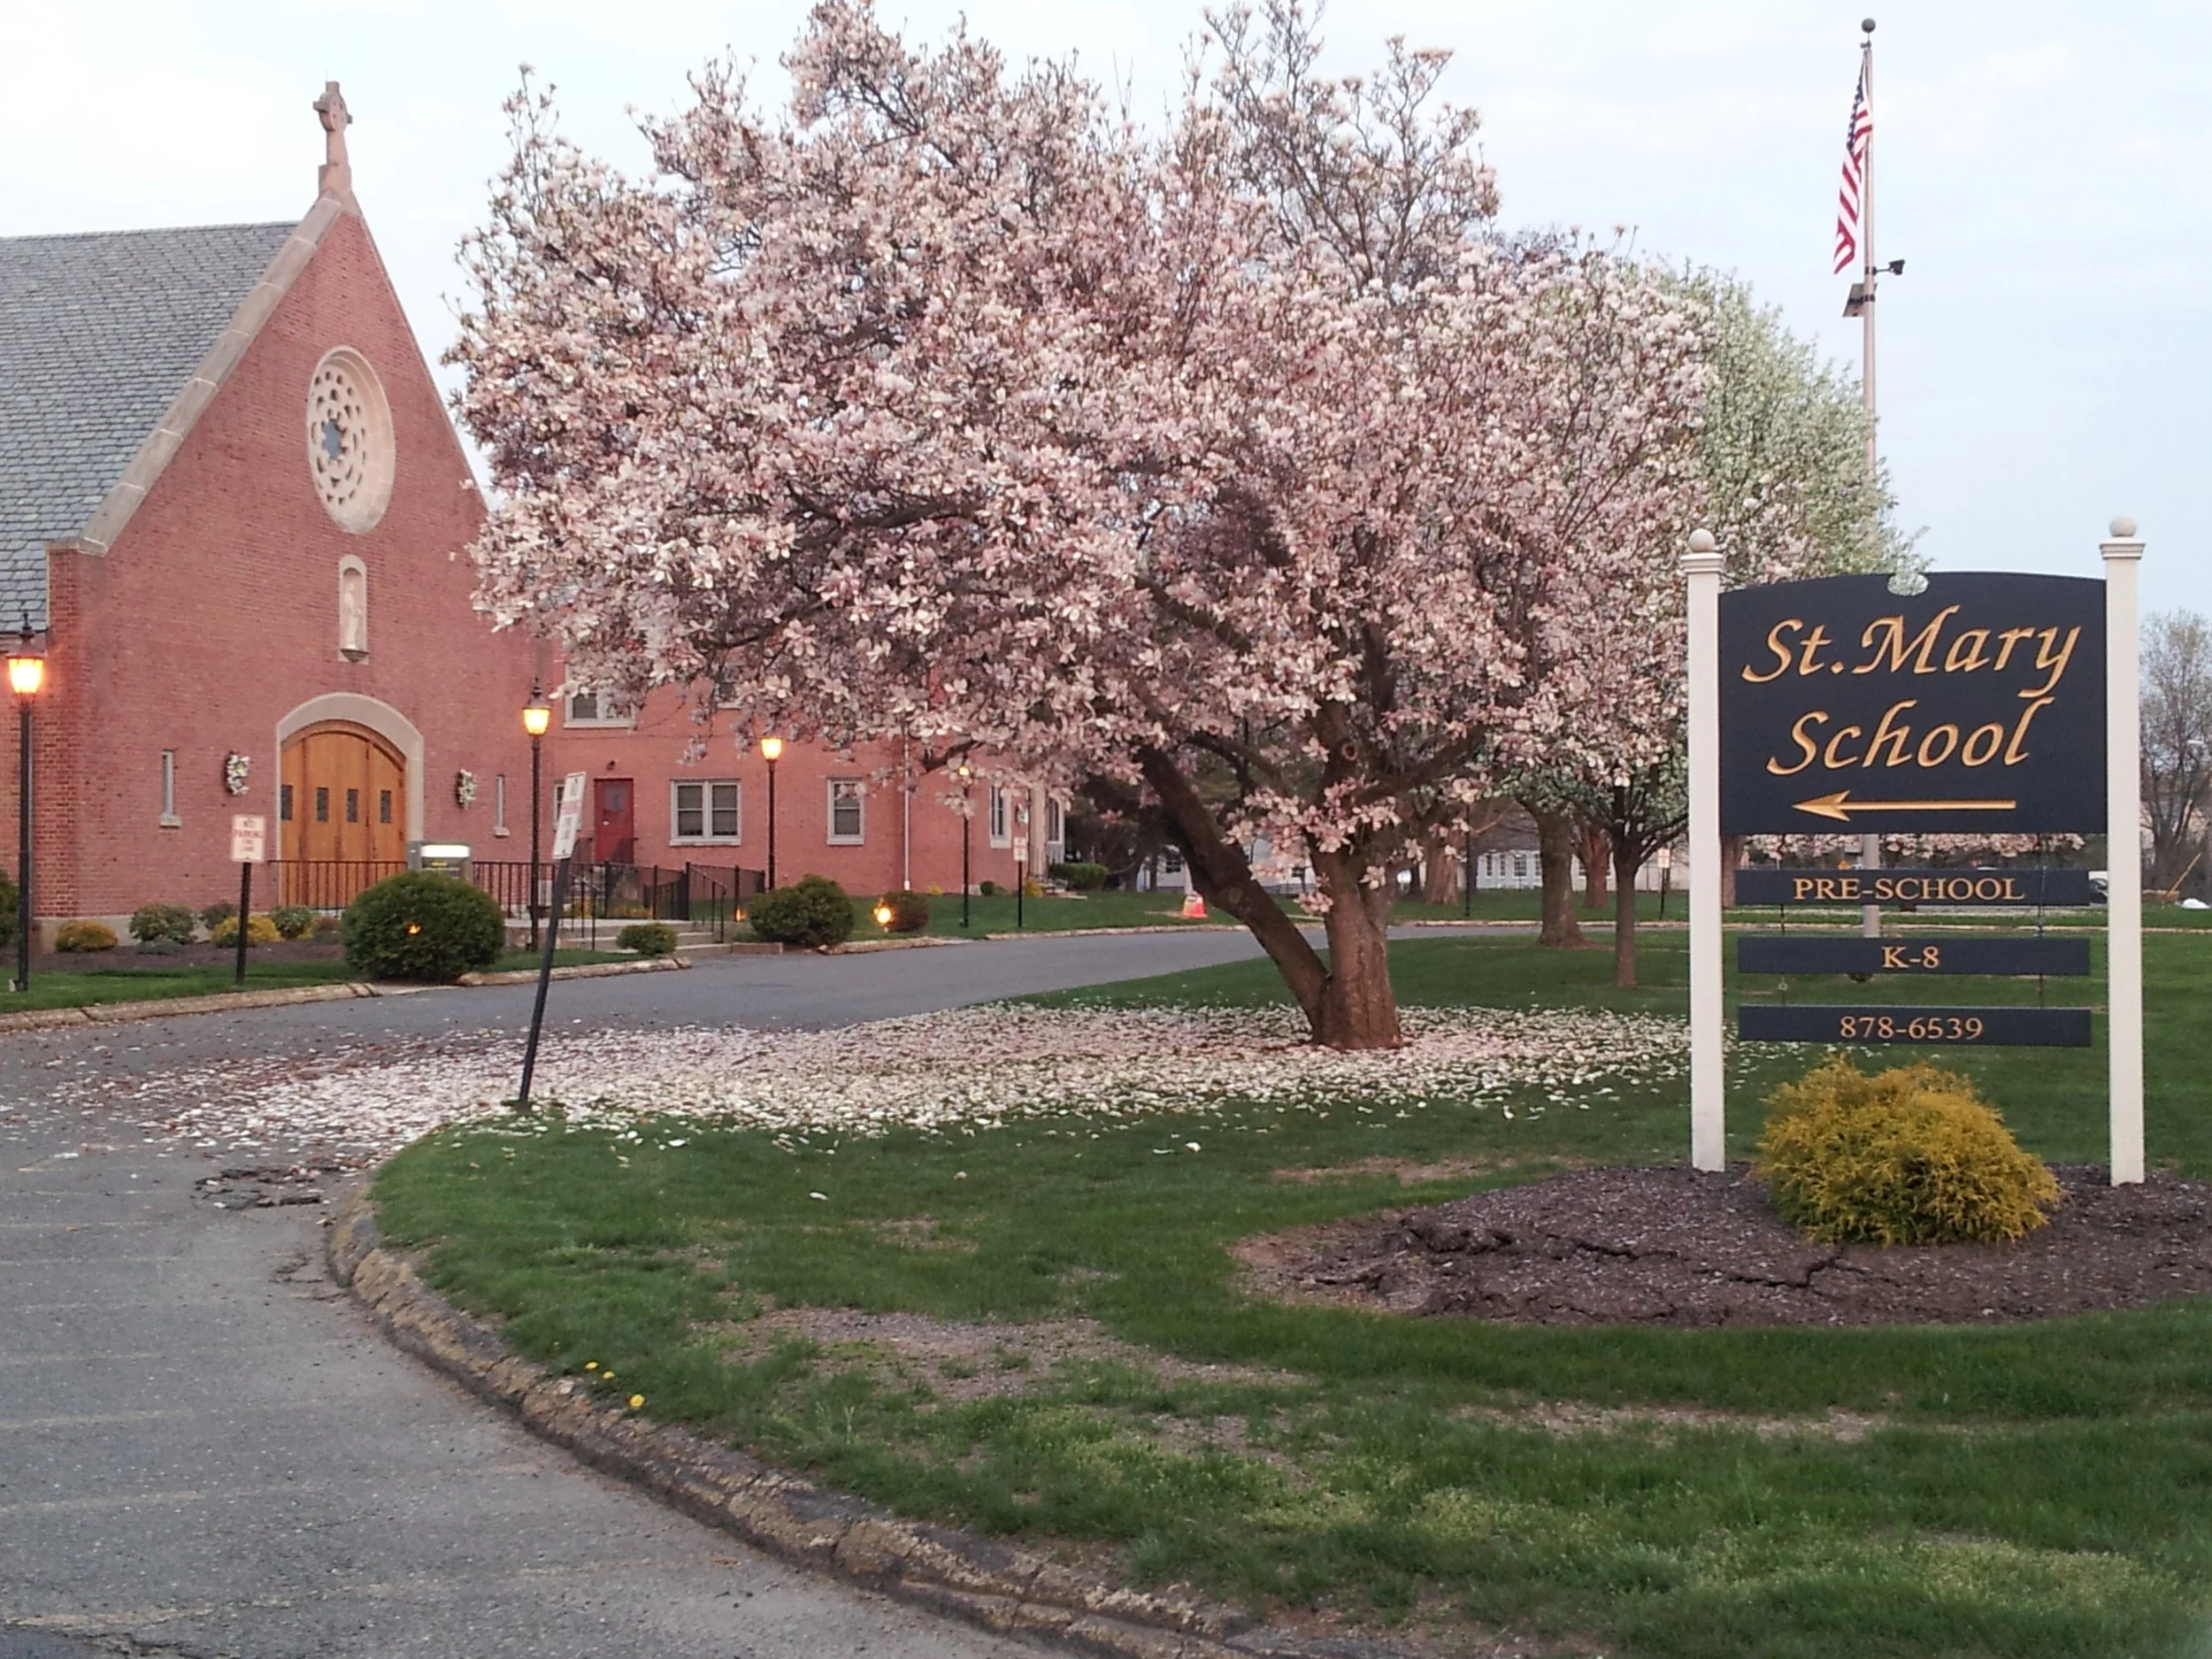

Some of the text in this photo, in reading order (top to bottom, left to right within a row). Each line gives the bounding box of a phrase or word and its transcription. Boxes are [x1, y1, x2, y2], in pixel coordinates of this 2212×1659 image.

[1765, 695, 2055, 776] School
[1793, 877, 2024, 900] PRE-SCHOOL
[1881, 946, 1941, 970] K-8
[1839, 1016, 1984, 1040] 878-6539
